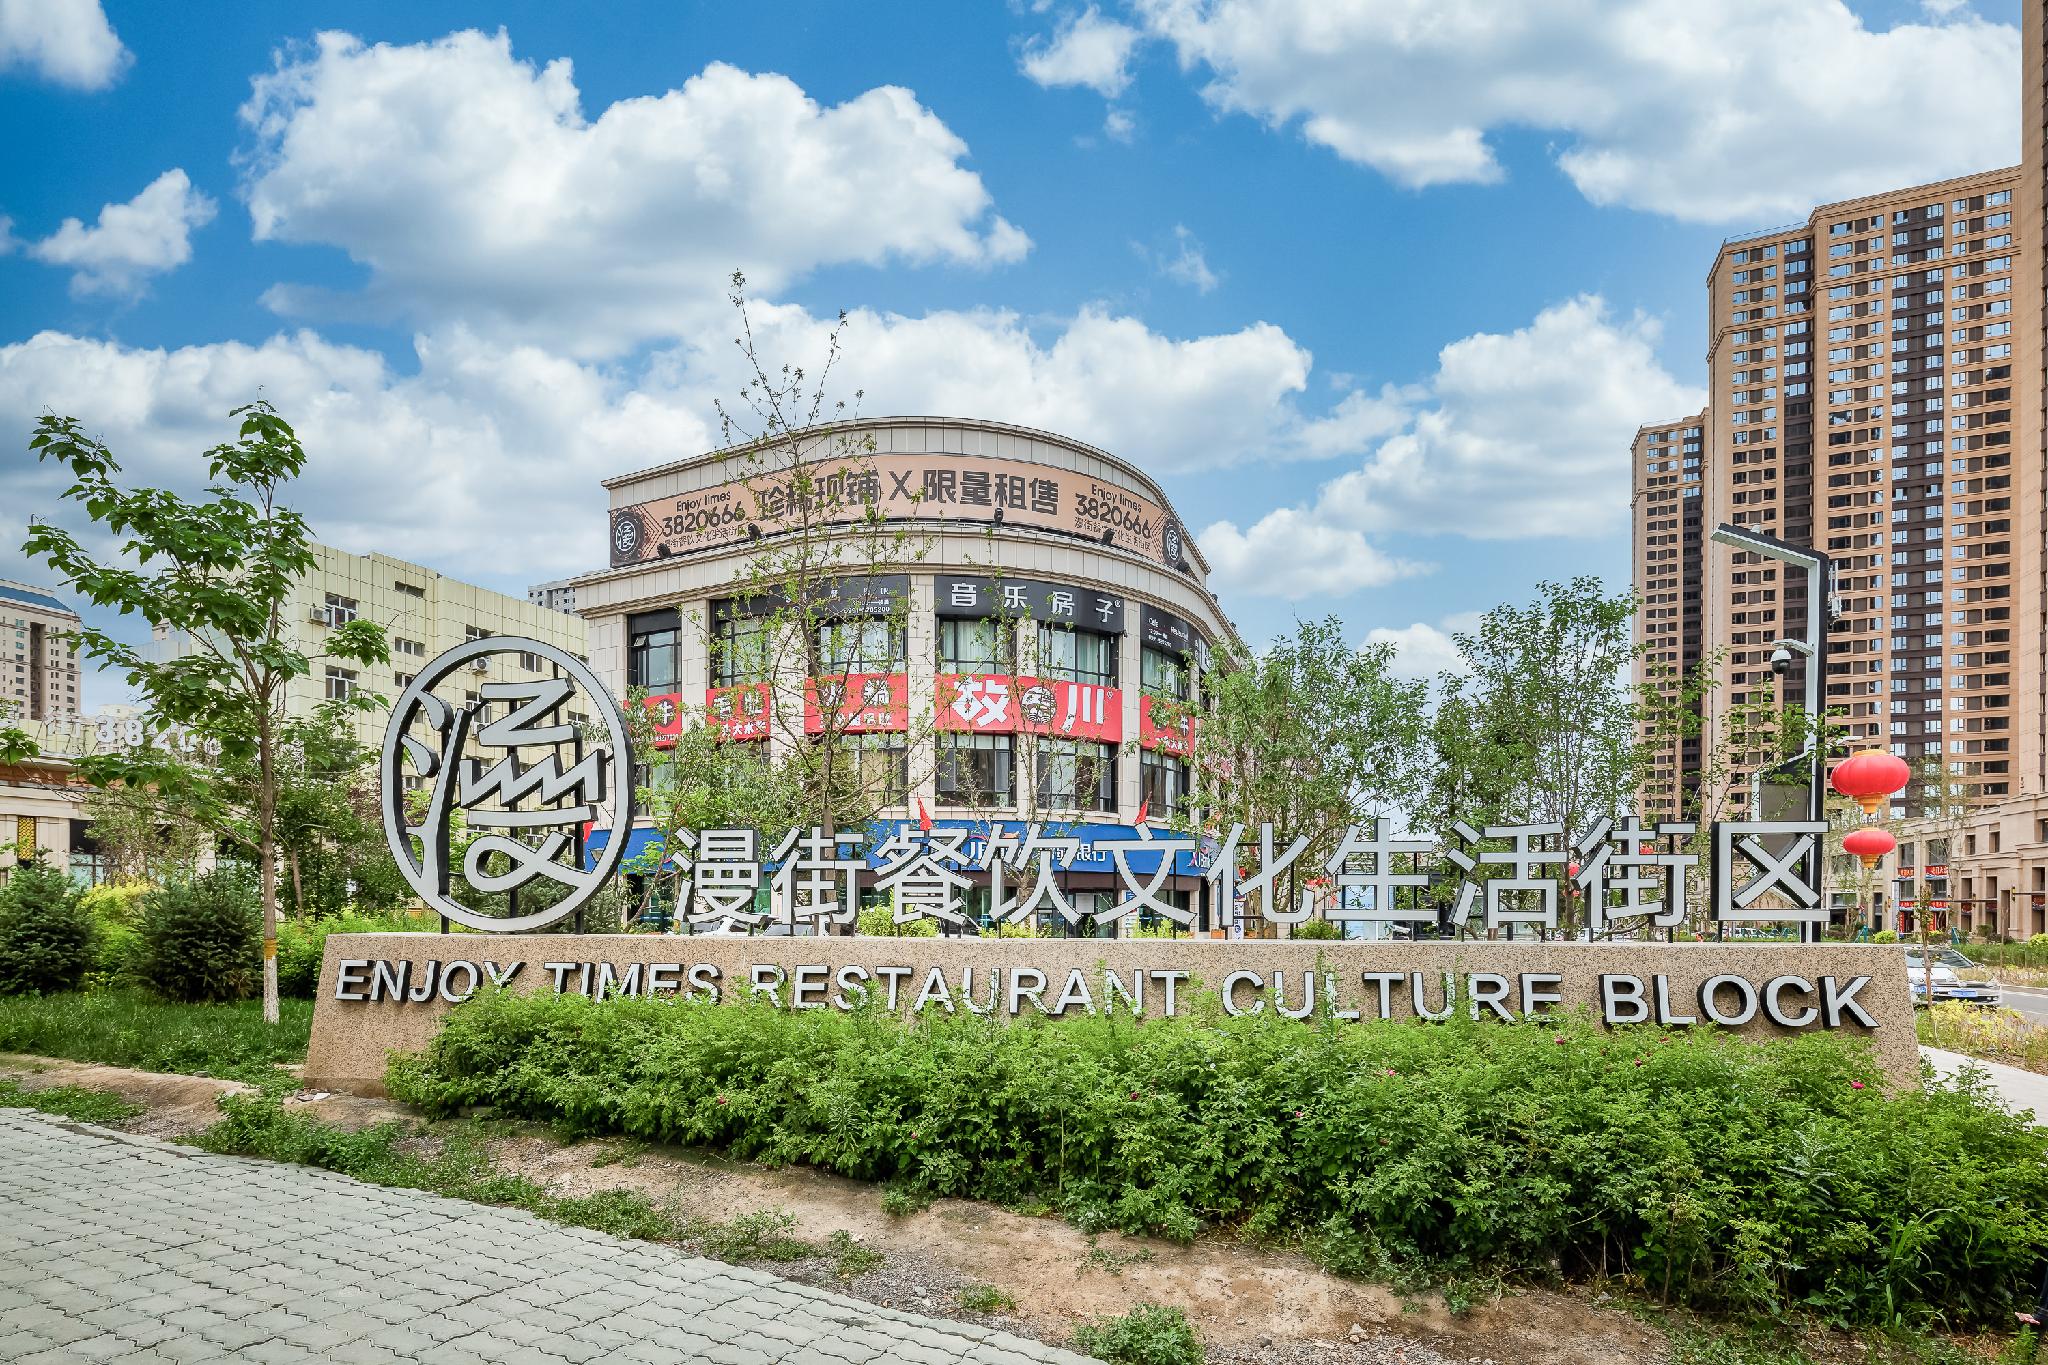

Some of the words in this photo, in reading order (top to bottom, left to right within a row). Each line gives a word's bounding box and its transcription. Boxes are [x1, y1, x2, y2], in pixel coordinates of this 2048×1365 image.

[662, 501, 746, 538] 3820666
[1074, 493, 1151, 540] 3820666
[951, 582, 1114, 623] 音乐房子
[671, 816, 1830, 929] 漫街餐饮文化生活街区
[335, 959, 525, 1004] ENJOY
[544, 961, 722, 1006] TIMES
[750, 963, 1190, 1016] RESTAURANT
[1221, 969, 1563, 1022] CULTURE
[1600, 973, 1881, 1028] BLOCK
